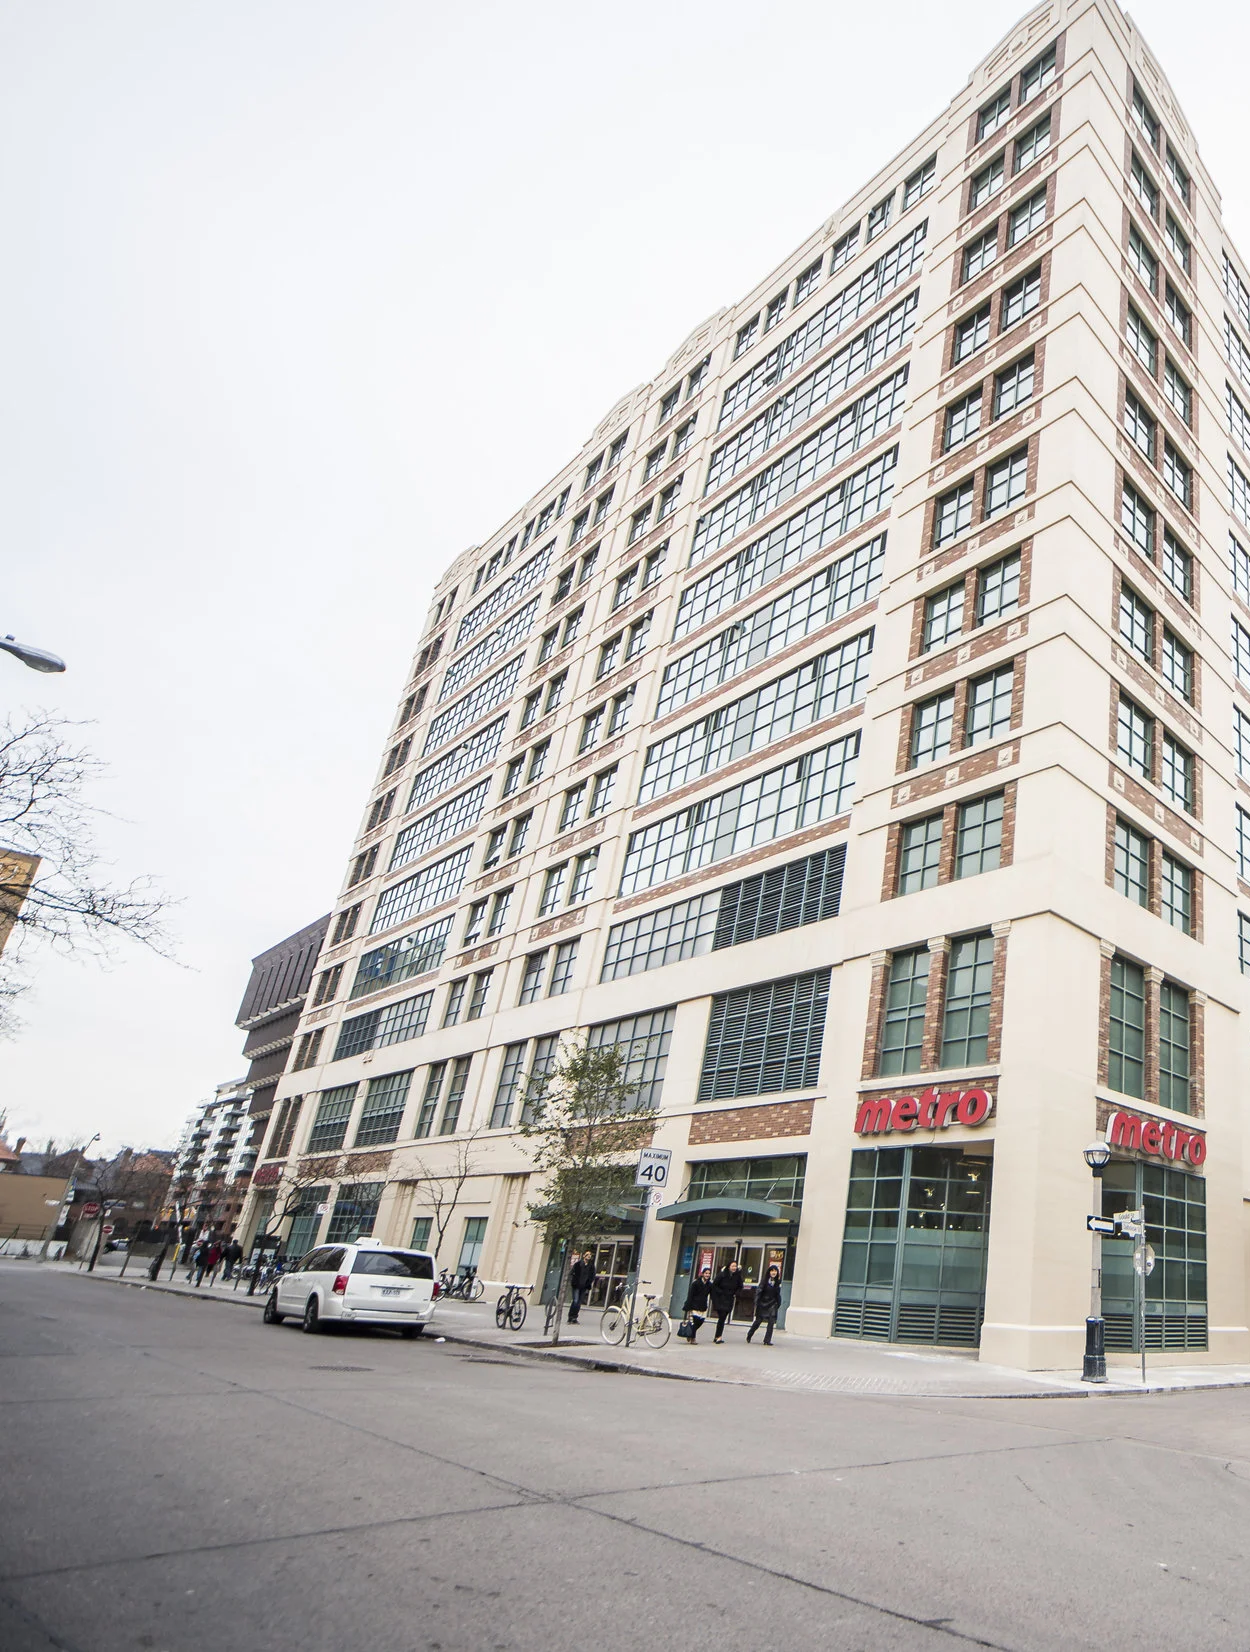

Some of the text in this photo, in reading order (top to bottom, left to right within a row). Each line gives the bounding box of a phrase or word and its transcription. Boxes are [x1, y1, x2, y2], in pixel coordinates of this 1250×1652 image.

[854, 1086, 993, 1132] metro
[1105, 1111, 1206, 1166] metro
[643, 1152, 669, 1160] MAXIMUM
[640, 1164, 666, 1182] 40
